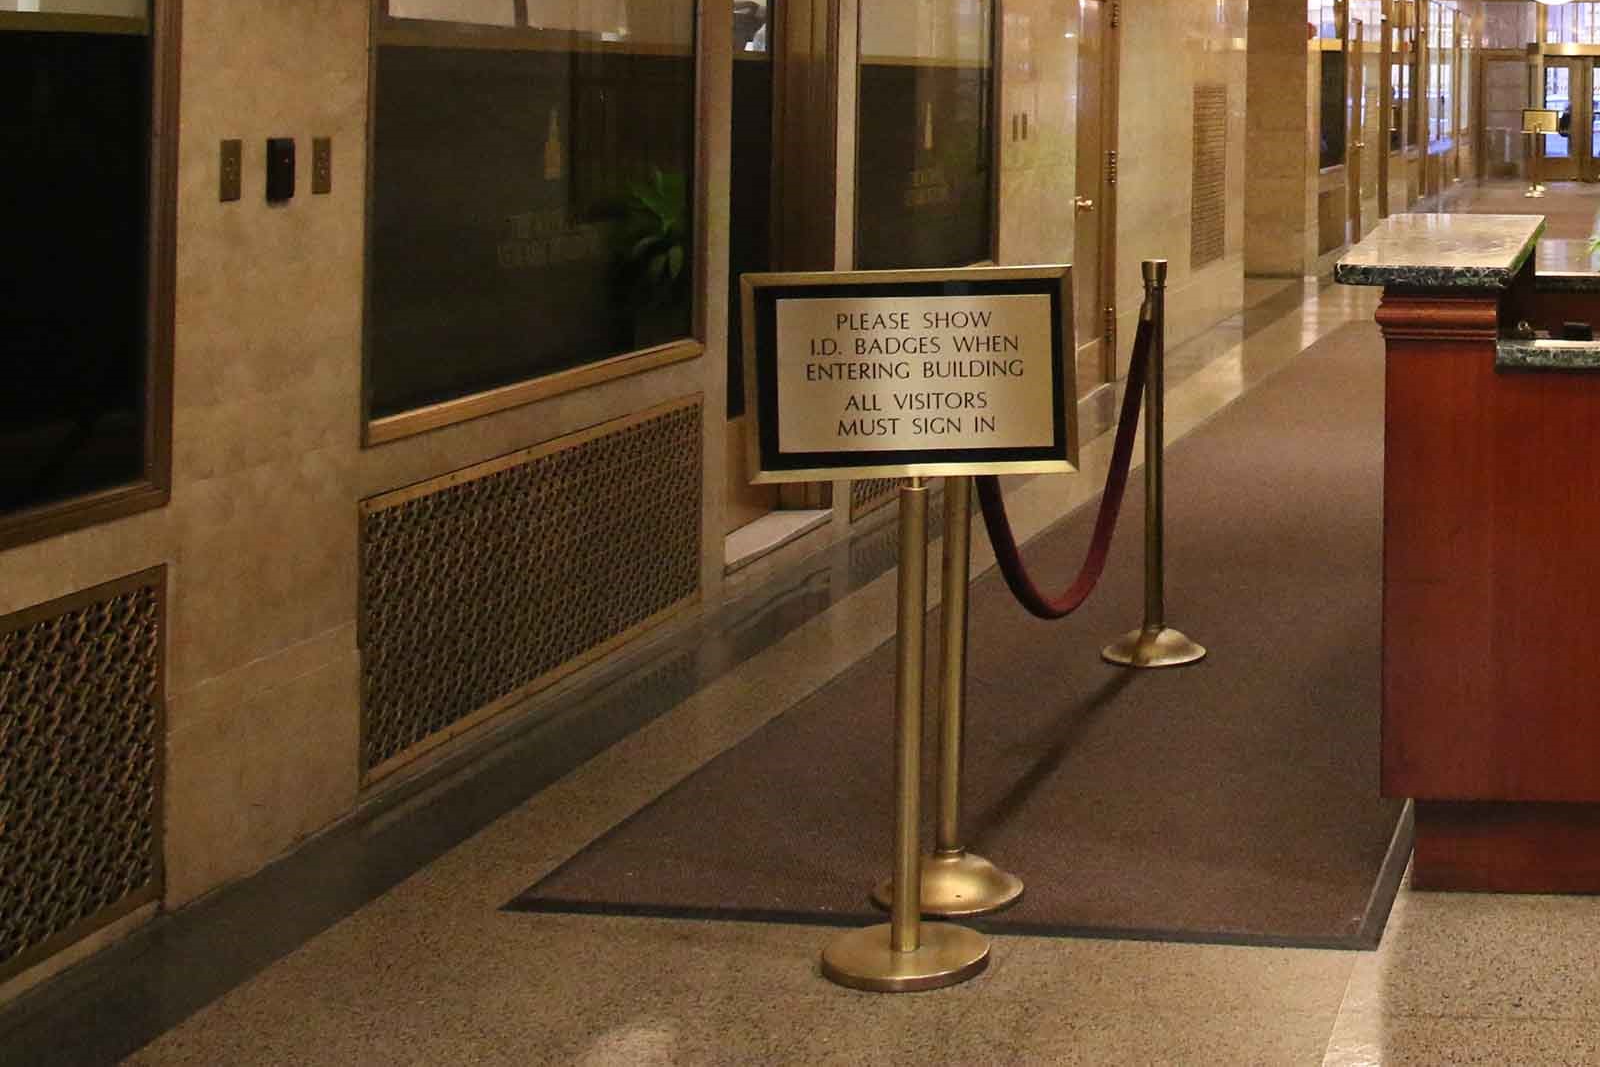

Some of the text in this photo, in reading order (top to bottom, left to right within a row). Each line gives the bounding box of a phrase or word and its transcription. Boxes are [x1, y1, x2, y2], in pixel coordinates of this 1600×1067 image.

[836, 311, 993, 331] PLEASE SHOW
[810, 335, 1019, 356] I.D. BADGES WHEN
[806, 359, 1024, 381] ENTERING BUILDING
[844, 392, 987, 412] ALL VISITORS
[837, 415, 996, 436] MUST SIGN IN
